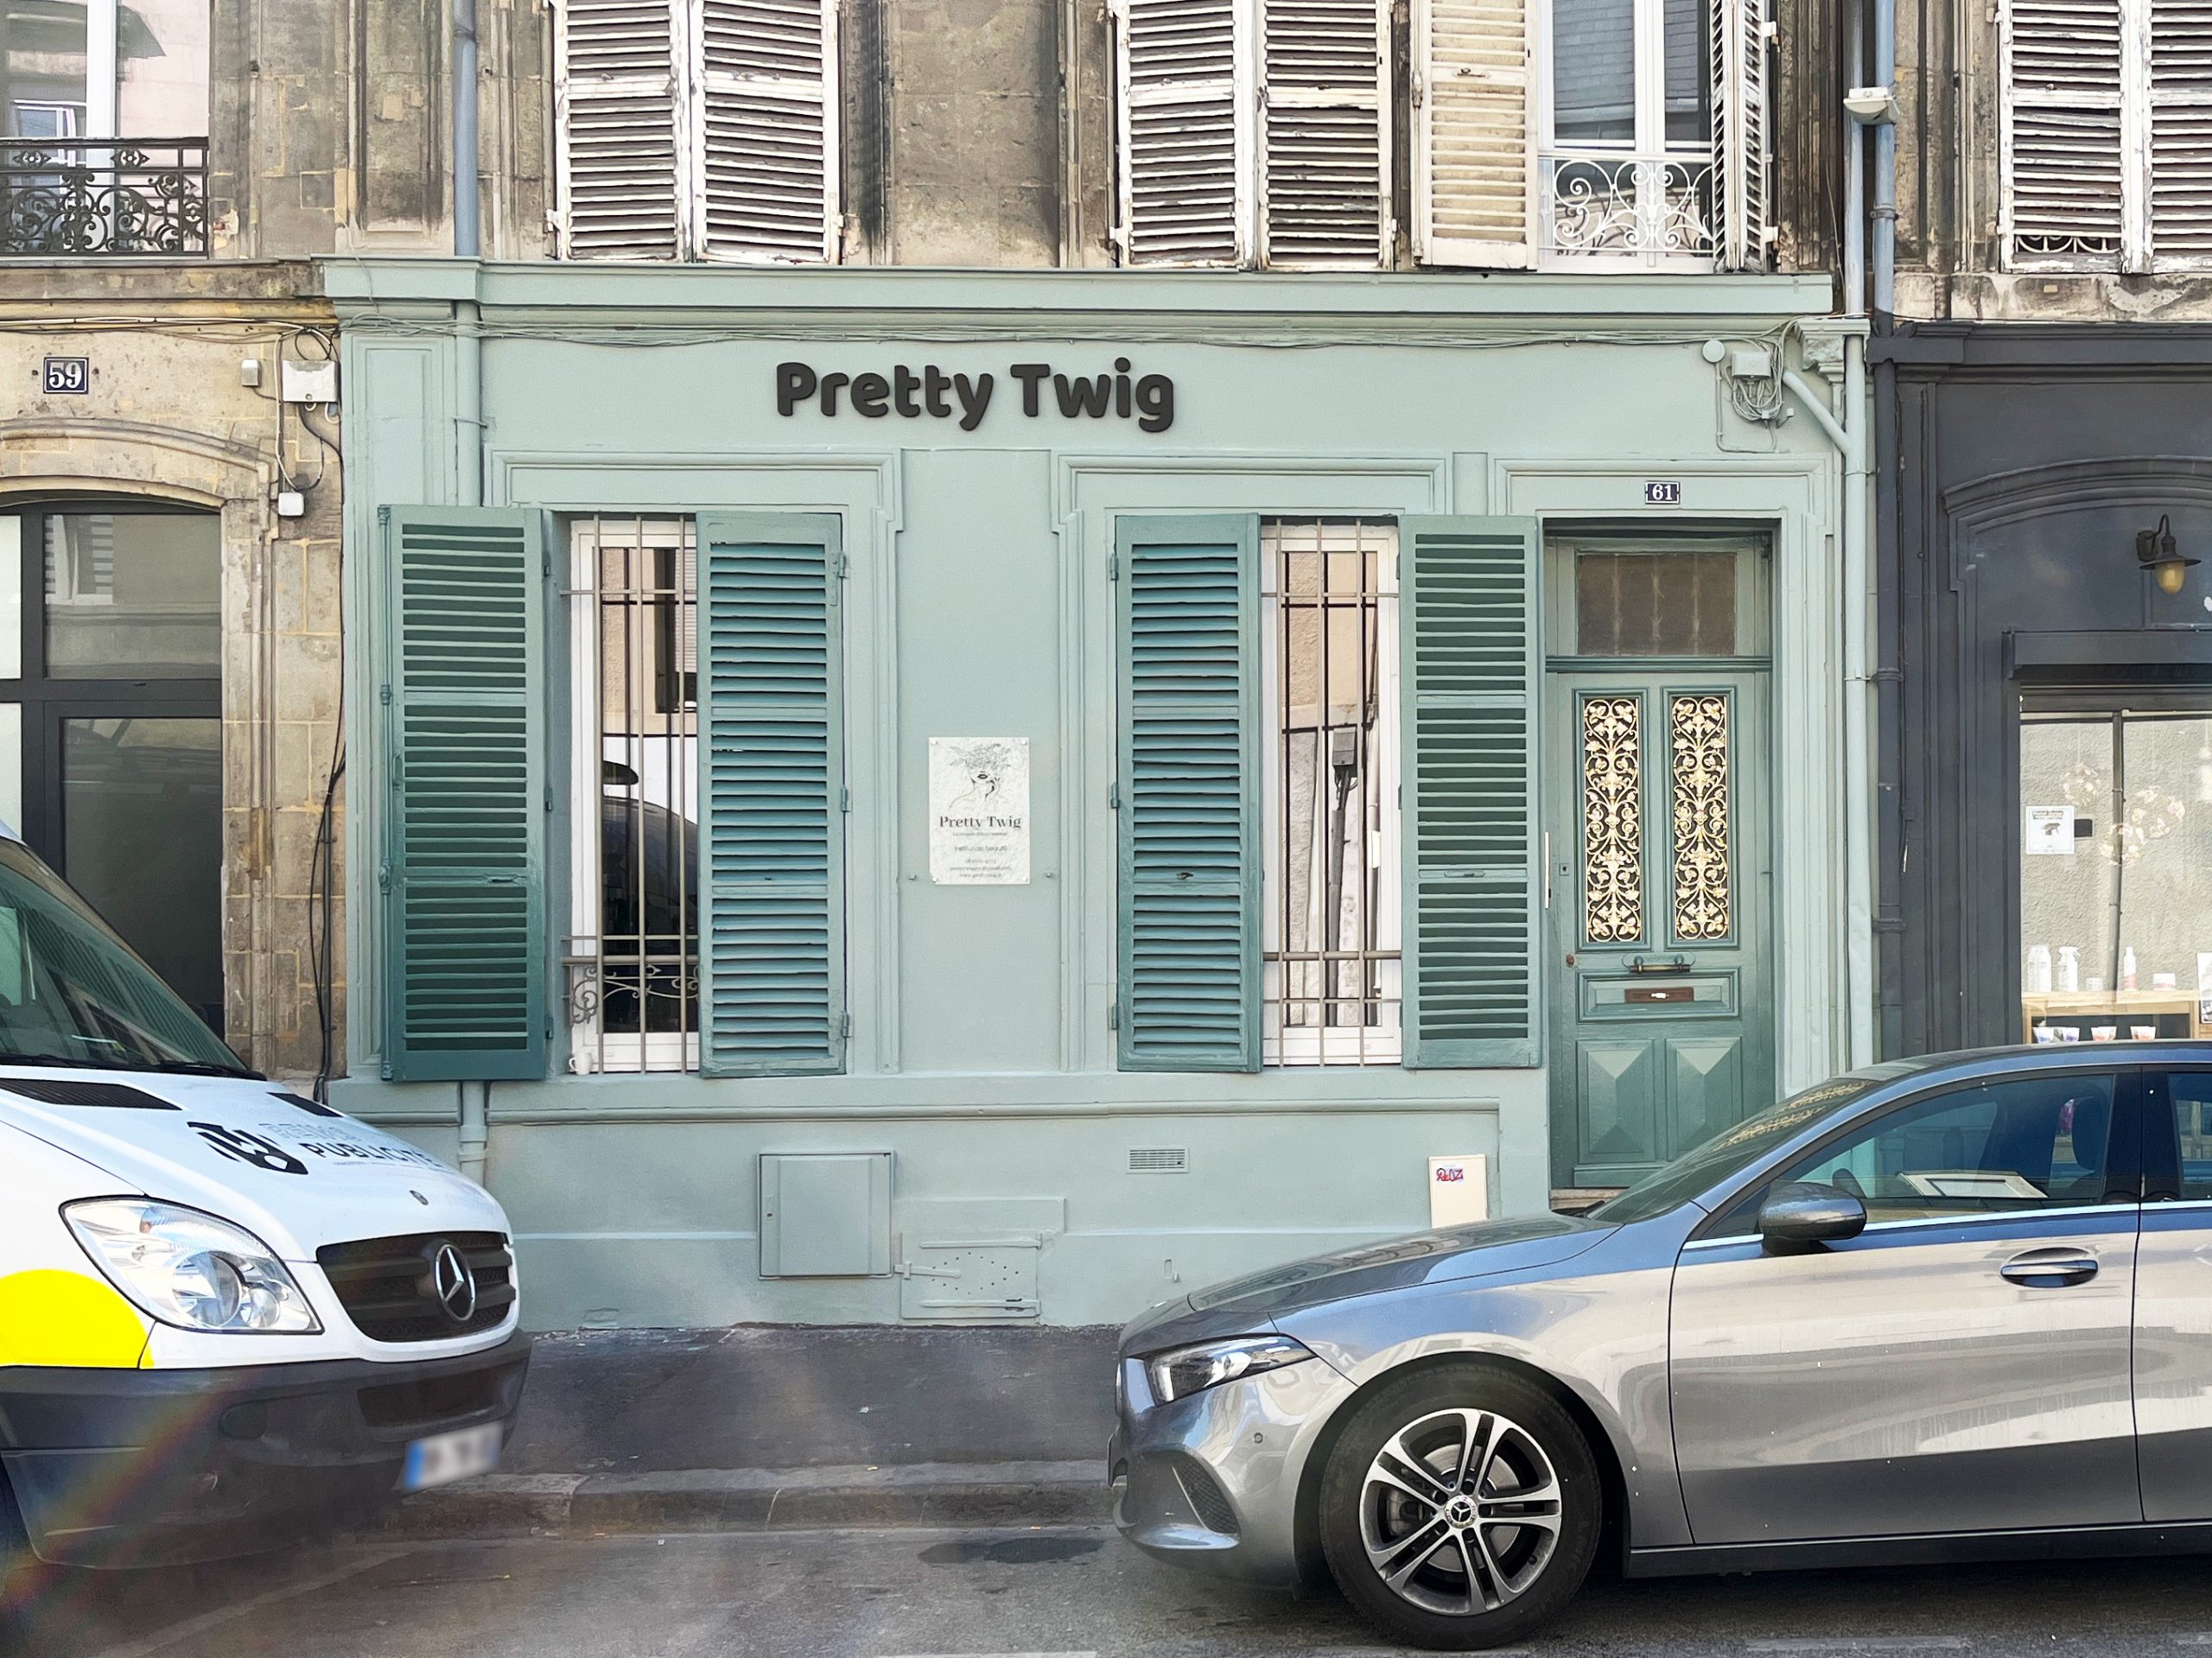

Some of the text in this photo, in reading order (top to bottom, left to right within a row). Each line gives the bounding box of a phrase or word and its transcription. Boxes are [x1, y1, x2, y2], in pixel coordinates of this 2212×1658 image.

[48, 361, 82, 389] 59
[776, 357, 1175, 433] Pretty Twig
[1652, 484, 1673, 500] 61
[939, 815, 1023, 830] Pretty Twig
